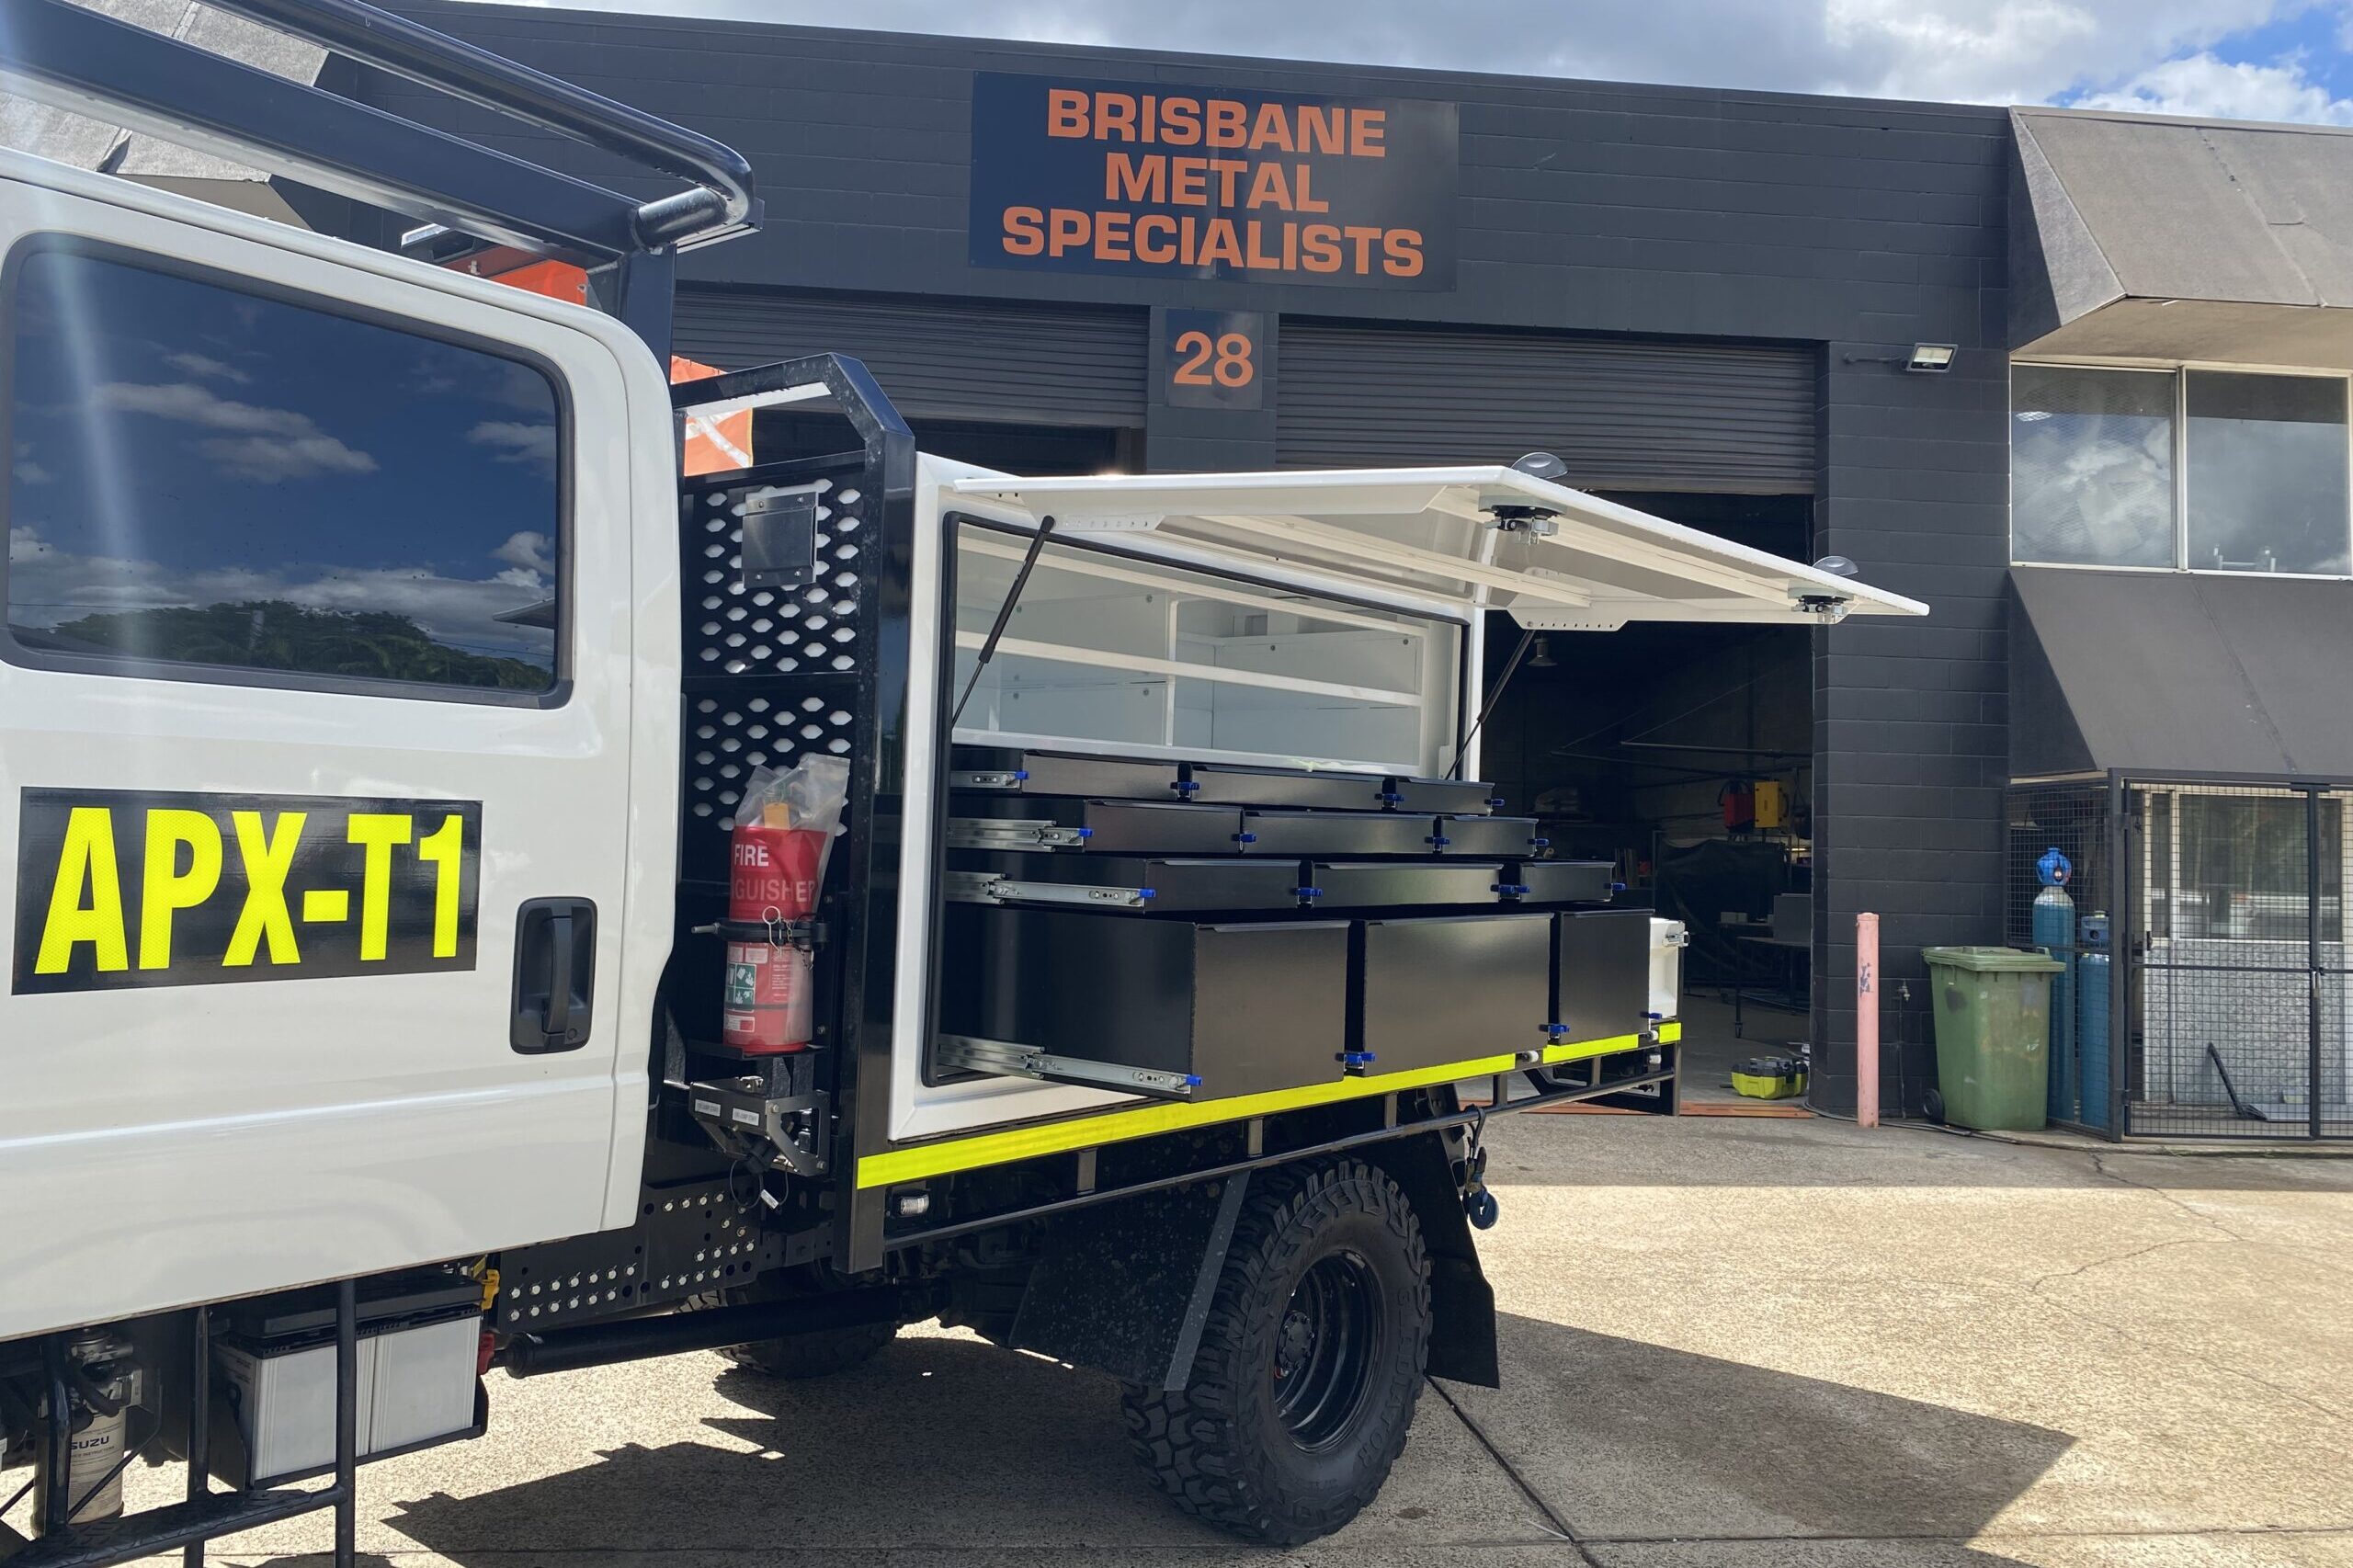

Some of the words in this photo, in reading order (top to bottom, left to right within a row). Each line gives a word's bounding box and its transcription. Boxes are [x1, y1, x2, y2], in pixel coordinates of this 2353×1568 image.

[1048, 88, 1386, 157] BRISBANE
[1106, 153, 1329, 212] METAL
[1002, 207, 1424, 277] SPECIALISTS
[1173, 331, 1254, 387] 28
[734, 844, 769, 867] FIRE
[34, 807, 463, 974] APX-T1
[69, 1436, 109, 1450] SUZU
